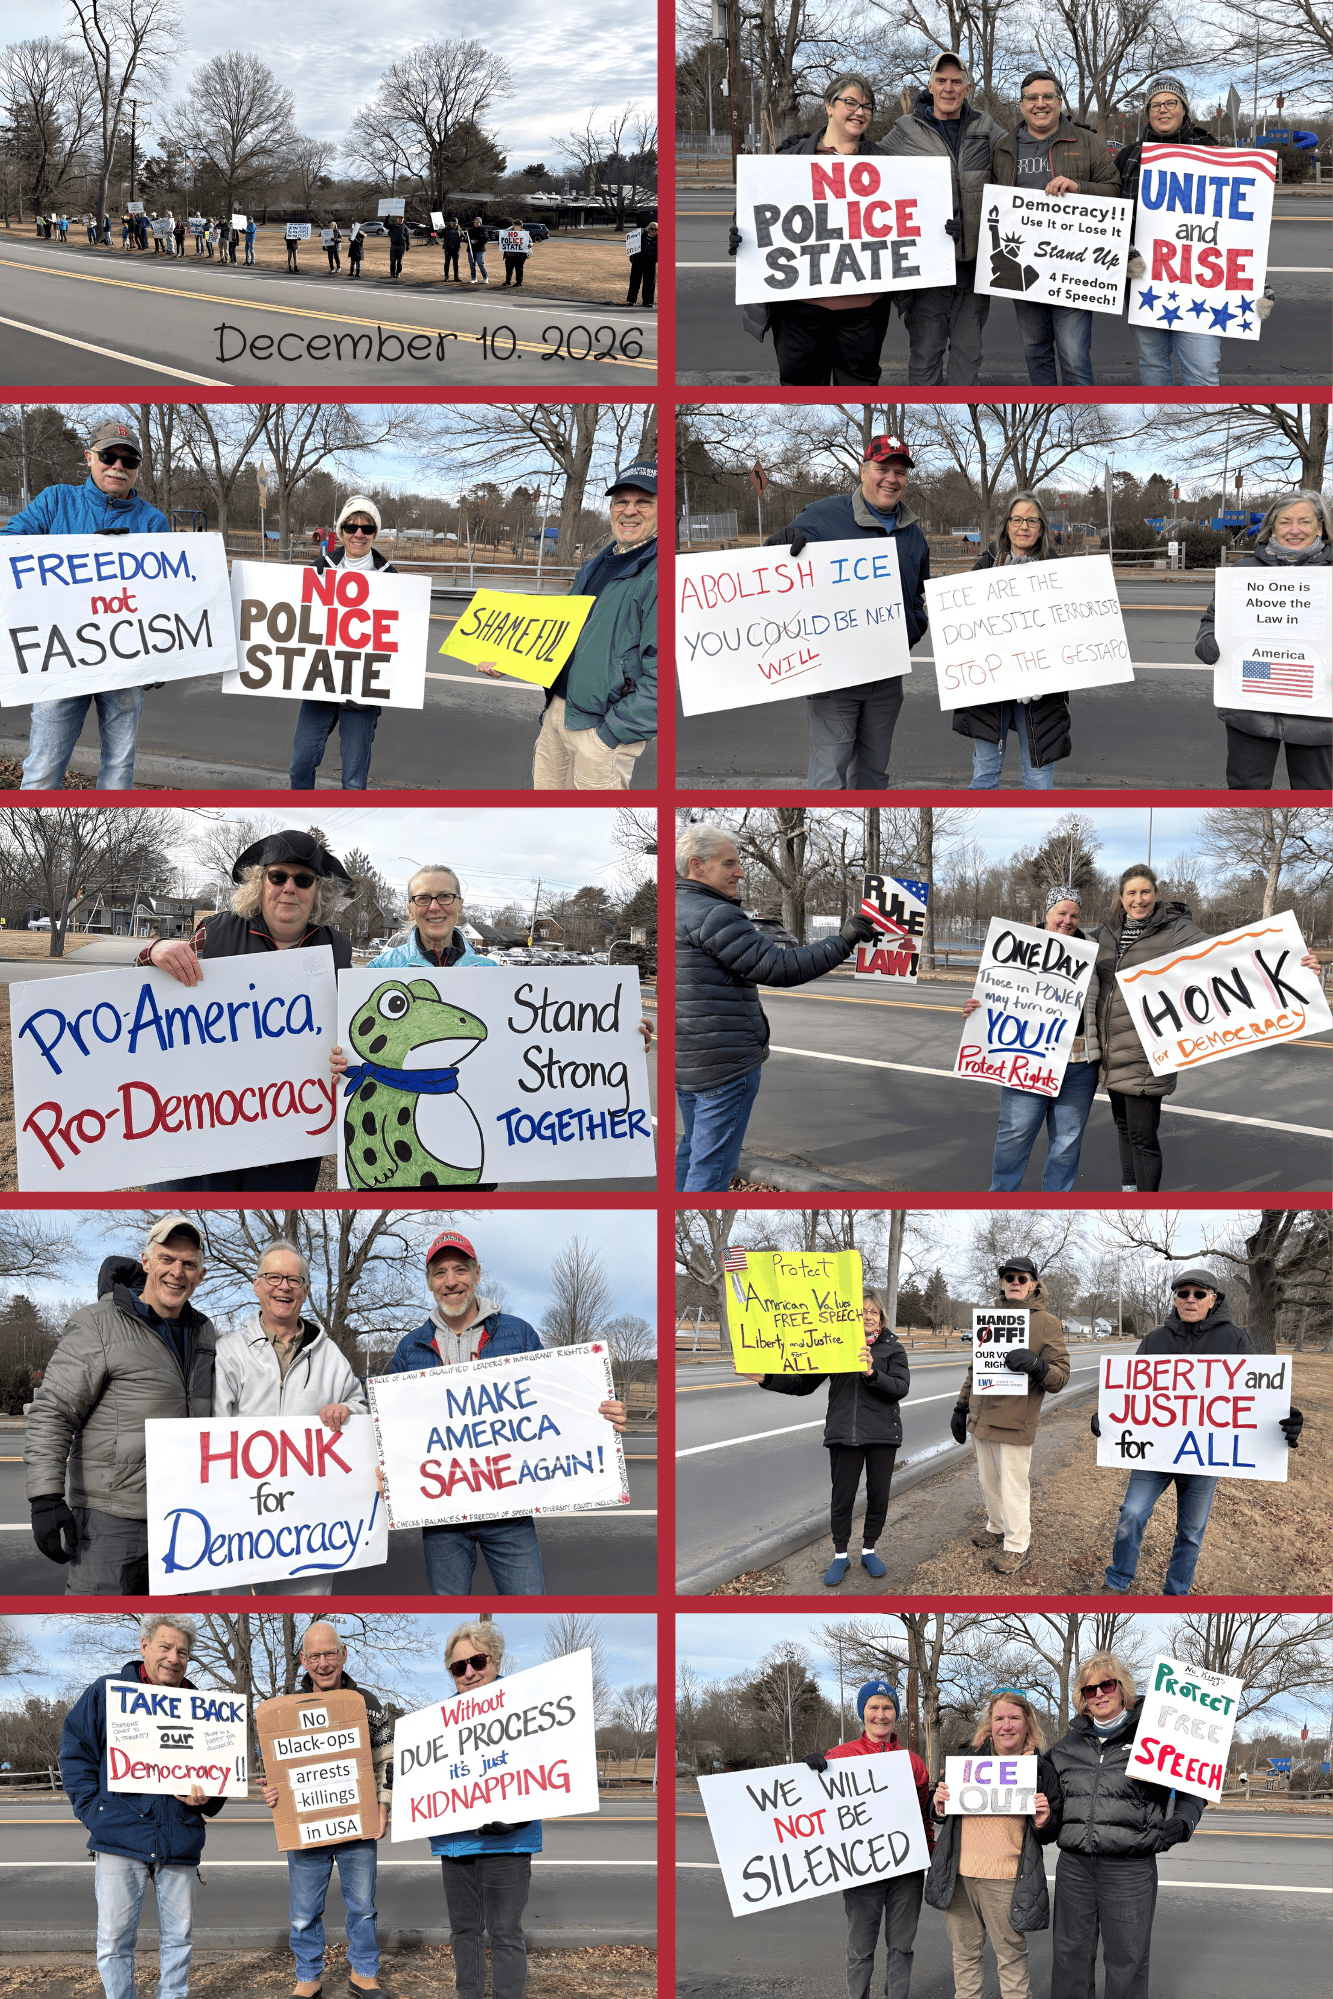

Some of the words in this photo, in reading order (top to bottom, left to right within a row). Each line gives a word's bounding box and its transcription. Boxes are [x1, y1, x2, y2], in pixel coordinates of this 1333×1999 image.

[811, 162, 881, 200] NO
[1141, 169, 1256, 221] UNITE
[753, 199, 921, 248] POLICE
[1012, 195, 1126, 223] Democracy!!
[1021, 216, 1044, 228] Use
[1047, 219, 1057, 229] It
[1060, 223, 1074, 231] or
[1078, 223, 1107, 236] Lose
[1111, 226, 1121, 237] It
[1175, 221, 1218, 245] and
[764, 239, 921, 290] STATE
[1034, 241, 1086, 263] Stand
[1093, 247, 1120, 271] Up
[1151, 239, 1254, 291] RISE
[1048, 287, 1061, 297] of
[1065, 289, 1116, 306] Speech!
[1049, 272, 1057, 282] 4
[1061, 274, 1118, 291] Freedom
[9, 550, 197, 589] FREEDOM,
[301, 567, 370, 608] NO
[681, 560, 814, 613] ABOLISH
[830, 555, 891, 584] ICE
[1247, 582, 1264, 591] No
[1269, 583, 1294, 591] One
[1299, 582, 1310, 591] is
[91, 587, 138, 615] not
[936, 586, 975, 611] ICE
[987, 578, 1020, 601] ARE
[1028, 572, 1062, 592] THE
[1246, 599, 1286, 608] Above
[1291, 599, 1311, 608] the
[240, 599, 399, 653] POLICE
[460, 607, 570, 663] SHAMEFUL
[684, 627, 740, 661] YOU
[747, 614, 830, 647] COULD
[834, 609, 858, 631] BE
[866, 603, 902, 625] NEXT
[943, 609, 1045, 645] DOMESTIC
[1048, 599, 1119, 624] TERRORISTS
[1257, 614, 1282, 624] Law
[1287, 614, 1298, 624] in
[9, 609, 212, 674] FASCISM
[1252, 648, 1305, 660] America
[239, 644, 391, 699] STATE
[758, 648, 820, 680] WILL
[944, 654, 1002, 690] STOP
[1011, 649, 1051, 672] THE
[1062, 639, 1128, 664] GESTAPO
[864, 875, 925, 936] RULE
[856, 947, 919, 977] LAW!
[992, 931, 1042, 969] ONE
[1041, 938, 1089, 980] DAY
[508, 982, 622, 1034] Stand
[980, 967, 1013, 989] Those
[1017, 982, 1029, 994] in
[1035, 981, 1084, 1011] POWER
[985, 992, 1009, 1011] may
[1013, 996, 1042, 1012] turn
[1046, 1008, 1062, 1017] on
[1142, 949, 1310, 1037] HONK
[18, 983, 322, 1076] Pro-America,
[987, 1008, 1068, 1051] YOU!!
[1152, 1049, 1170, 1066] for
[1176, 1006, 1306, 1058] DEMOCRACY
[518, 1044, 630, 1118] Strong
[958, 1045, 1006, 1079] Protect
[1008, 1055, 1059, 1091] Rights
[22, 1075, 337, 1170] Pro-Democracy
[496, 1107, 651, 1146] TOGETHER
[772, 1254, 834, 1278] Protect
[774, 1312, 813, 1328] FREE
[819, 1309, 863, 1324] SPEECH
[977, 1315, 1025, 1325] HANDS
[977, 1327, 1025, 1343] OFF!
[557, 1346, 590, 1357] RIGHTS
[741, 1324, 784, 1360] Liberty
[790, 1339, 804, 1348] and
[804, 1329, 843, 1348] Justice
[374, 1376, 389, 1384] RULE
[402, 1372, 417, 1380] LAW
[783, 1357, 819, 1372] ALL
[1105, 1359, 1247, 1391] LIBERTY
[1245, 1362, 1286, 1390] and
[446, 1376, 537, 1418] MAKE
[1109, 1393, 1257, 1429] JUSTICE
[427, 1414, 561, 1453] AMERICA
[1115, 1430, 1154, 1459] for
[1173, 1431, 1256, 1468] ALL
[200, 1428, 352, 1484] HONK
[420, 1453, 518, 1500] SANE
[518, 1446, 605, 1484] AGAIN!
[250, 1482, 295, 1515] for
[469, 1511, 499, 1521] FREEDOM
[162, 1491, 380, 1576] Democracy!
[396, 1520, 420, 1528] CHECKS
[425, 1515, 460, 1526] BALANCES
[1155, 1663, 1235, 1715] PROTECT
[1185, 1666, 1197, 1674] No
[110, 1686, 182, 1719] TAKE
[190, 1696, 245, 1722] BACK
[303, 1712, 326, 1728] No
[441, 1689, 506, 1728] Without
[160, 1733, 194, 1744] our
[278, 1732, 355, 1755] black-ops
[400, 1735, 448, 1776] DUE
[459, 1695, 576, 1755] PROCESS
[1158, 1705, 1223, 1744] FREE
[297, 1764, 350, 1784] arrests
[450, 1760, 471, 1780] it's
[479, 1750, 509, 1778] just
[963, 1760, 1018, 1785] ICE
[1134, 1737, 1222, 1790] SPEECH
[297, 1789, 355, 1807] -killings
[410, 1759, 571, 1823] KIDNAPPING
[746, 1778, 802, 1811] WE
[818, 1769, 888, 1800] WILL
[959, 1786, 1035, 1813] OUT
[307, 1826, 321, 1839] in
[326, 1820, 358, 1836] USA
[774, 1808, 826, 1844] NOT
[837, 1801, 872, 1831] BE
[742, 1830, 910, 1902] SILENCED
